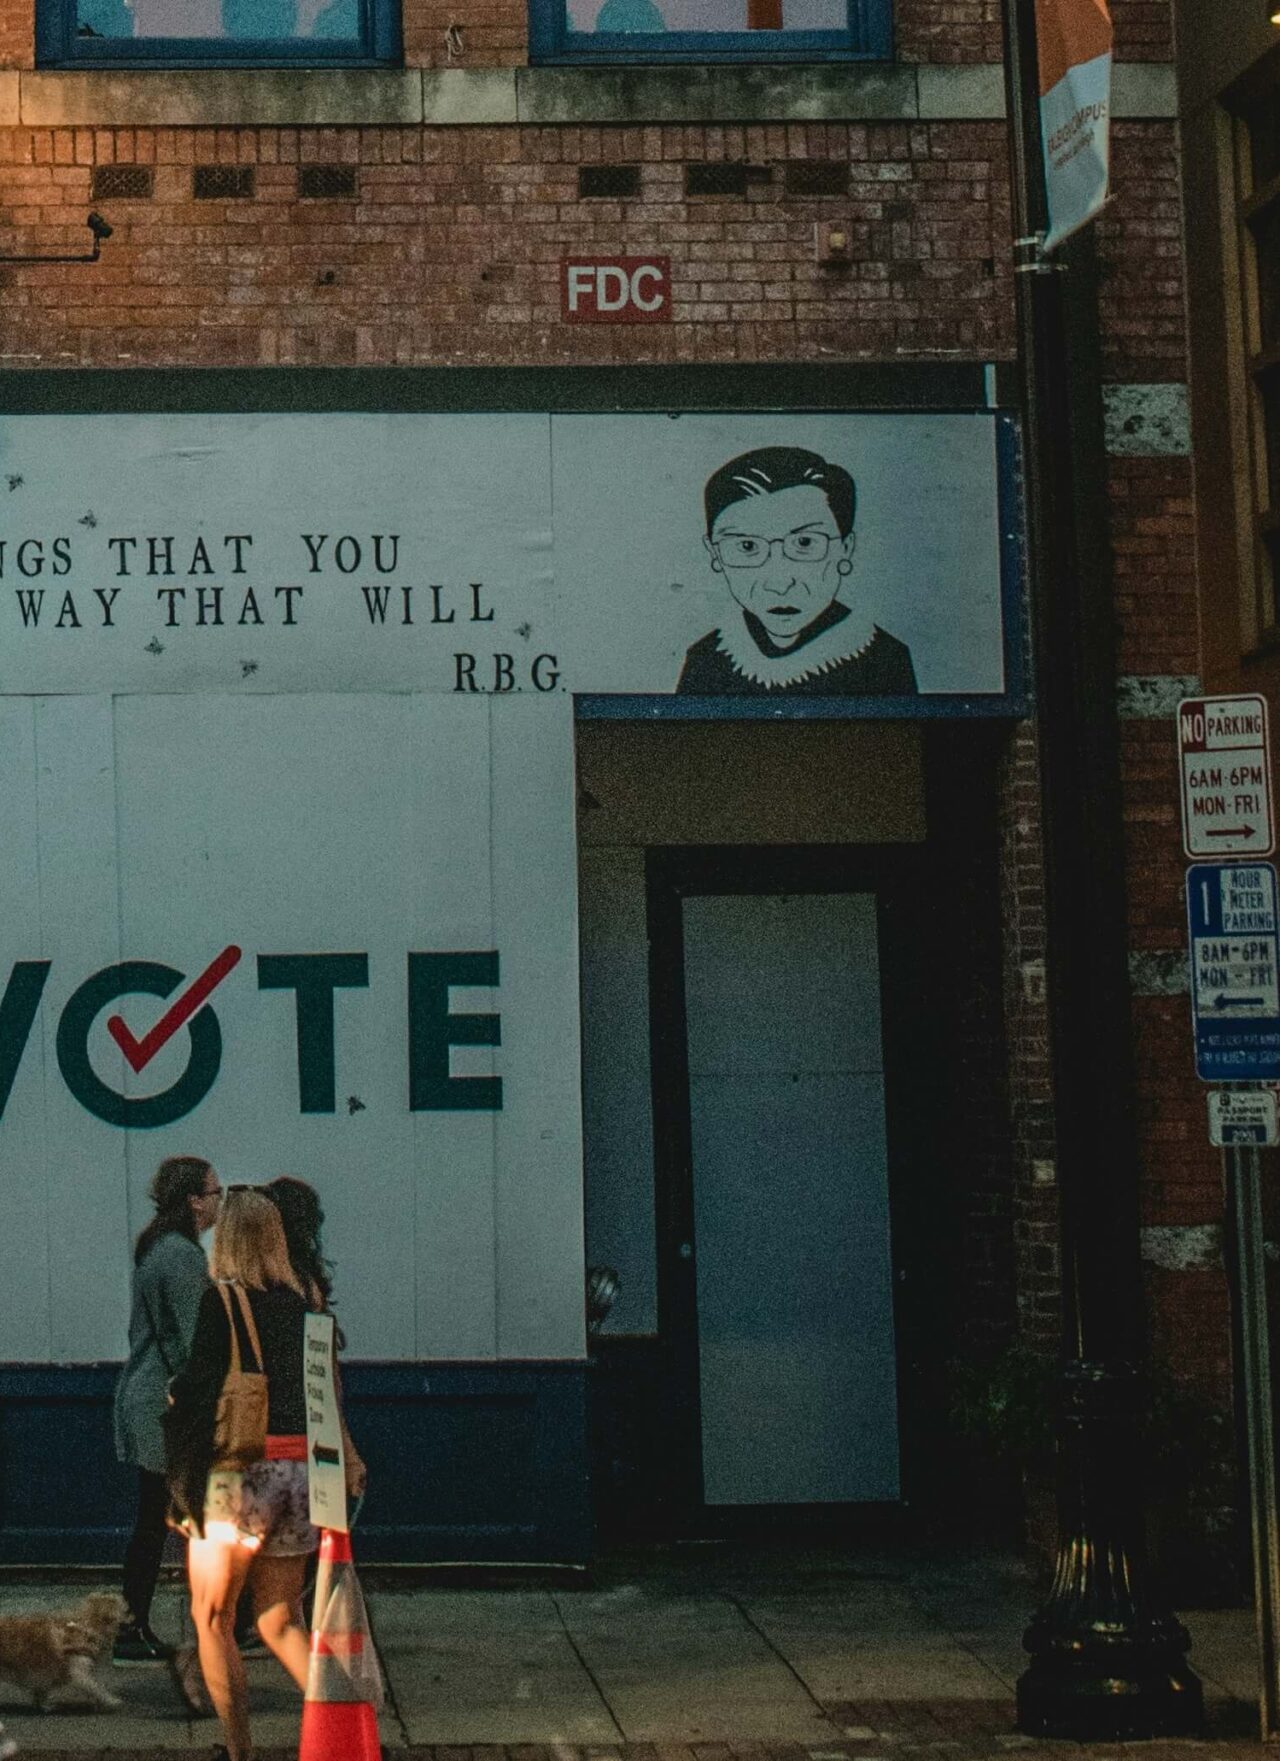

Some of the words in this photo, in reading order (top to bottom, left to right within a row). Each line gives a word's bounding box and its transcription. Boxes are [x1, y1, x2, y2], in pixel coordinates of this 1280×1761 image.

[567, 265, 664, 311] FDC
[108, 534, 253, 576] THAT
[301, 534, 401, 574] YOU
[16, 588, 121, 628] WAY
[157, 586, 303, 627] THAT
[361, 583, 496, 625] WILL
[1181, 714, 1204, 743] NO
[1207, 715, 1262, 736] PARKING
[1230, 869, 1261, 888] HOUR
[1200, 880, 1210, 926] 1
[1230, 889, 1264, 909] METER
[1223, 911, 1273, 931] PARKING
